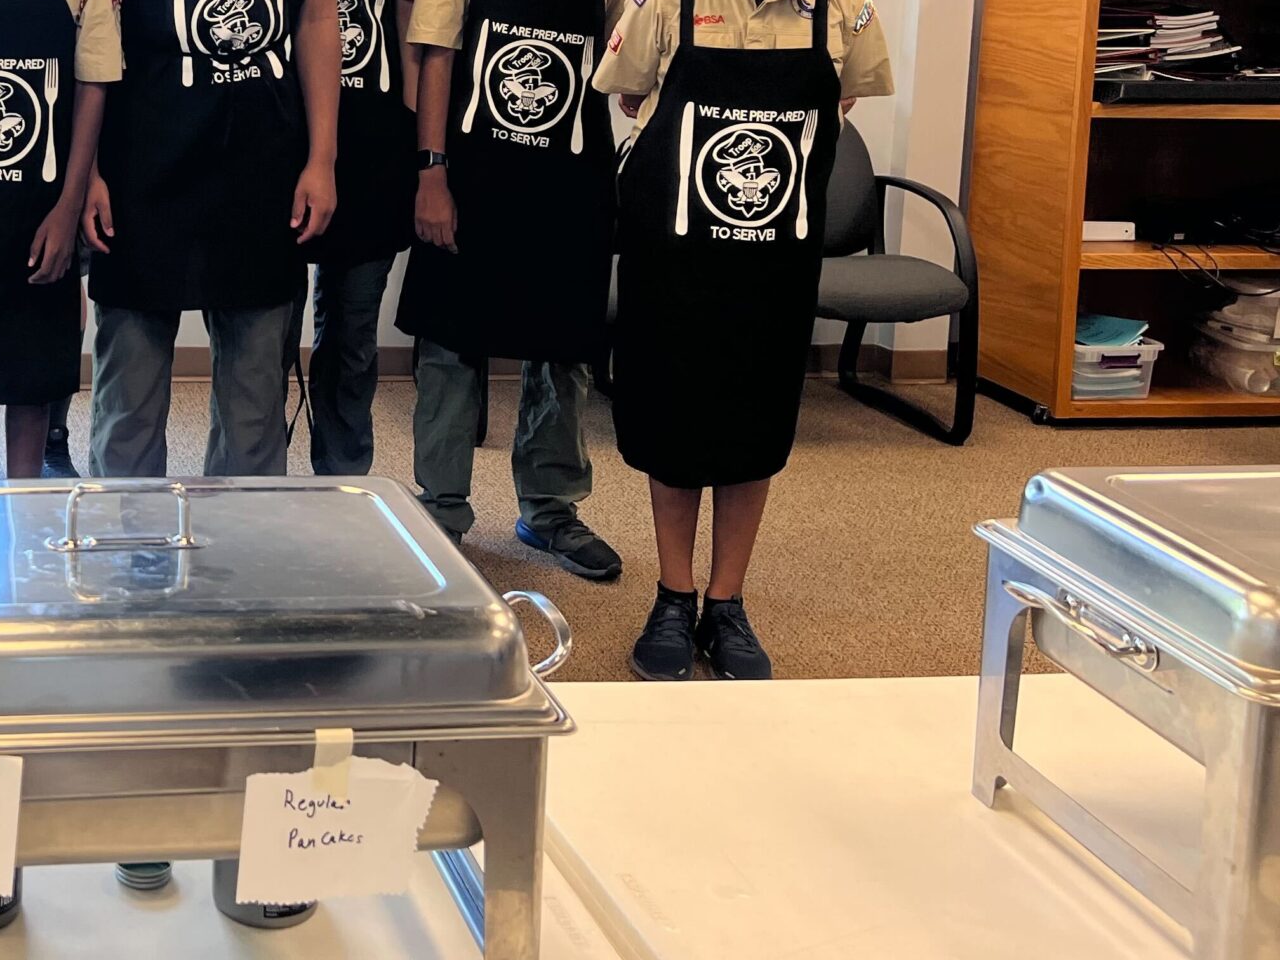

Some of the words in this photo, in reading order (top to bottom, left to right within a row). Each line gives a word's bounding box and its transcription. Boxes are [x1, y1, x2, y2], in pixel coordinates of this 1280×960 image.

[703, 14, 726, 25] BSA
[492, 21, 509, 35] WE
[509, 25, 532, 38] ARE
[532, 28, 584, 45] PREPARED
[511, 52, 533, 68] Troop
[699, 104, 721, 119] WE
[721, 108, 748, 121] ARE
[749, 110, 806, 122] PREPARED
[491, 127, 509, 140] TO
[728, 137, 752, 157] Troop
[710, 225, 731, 239] TO
[284, 788, 351, 818] Regula
